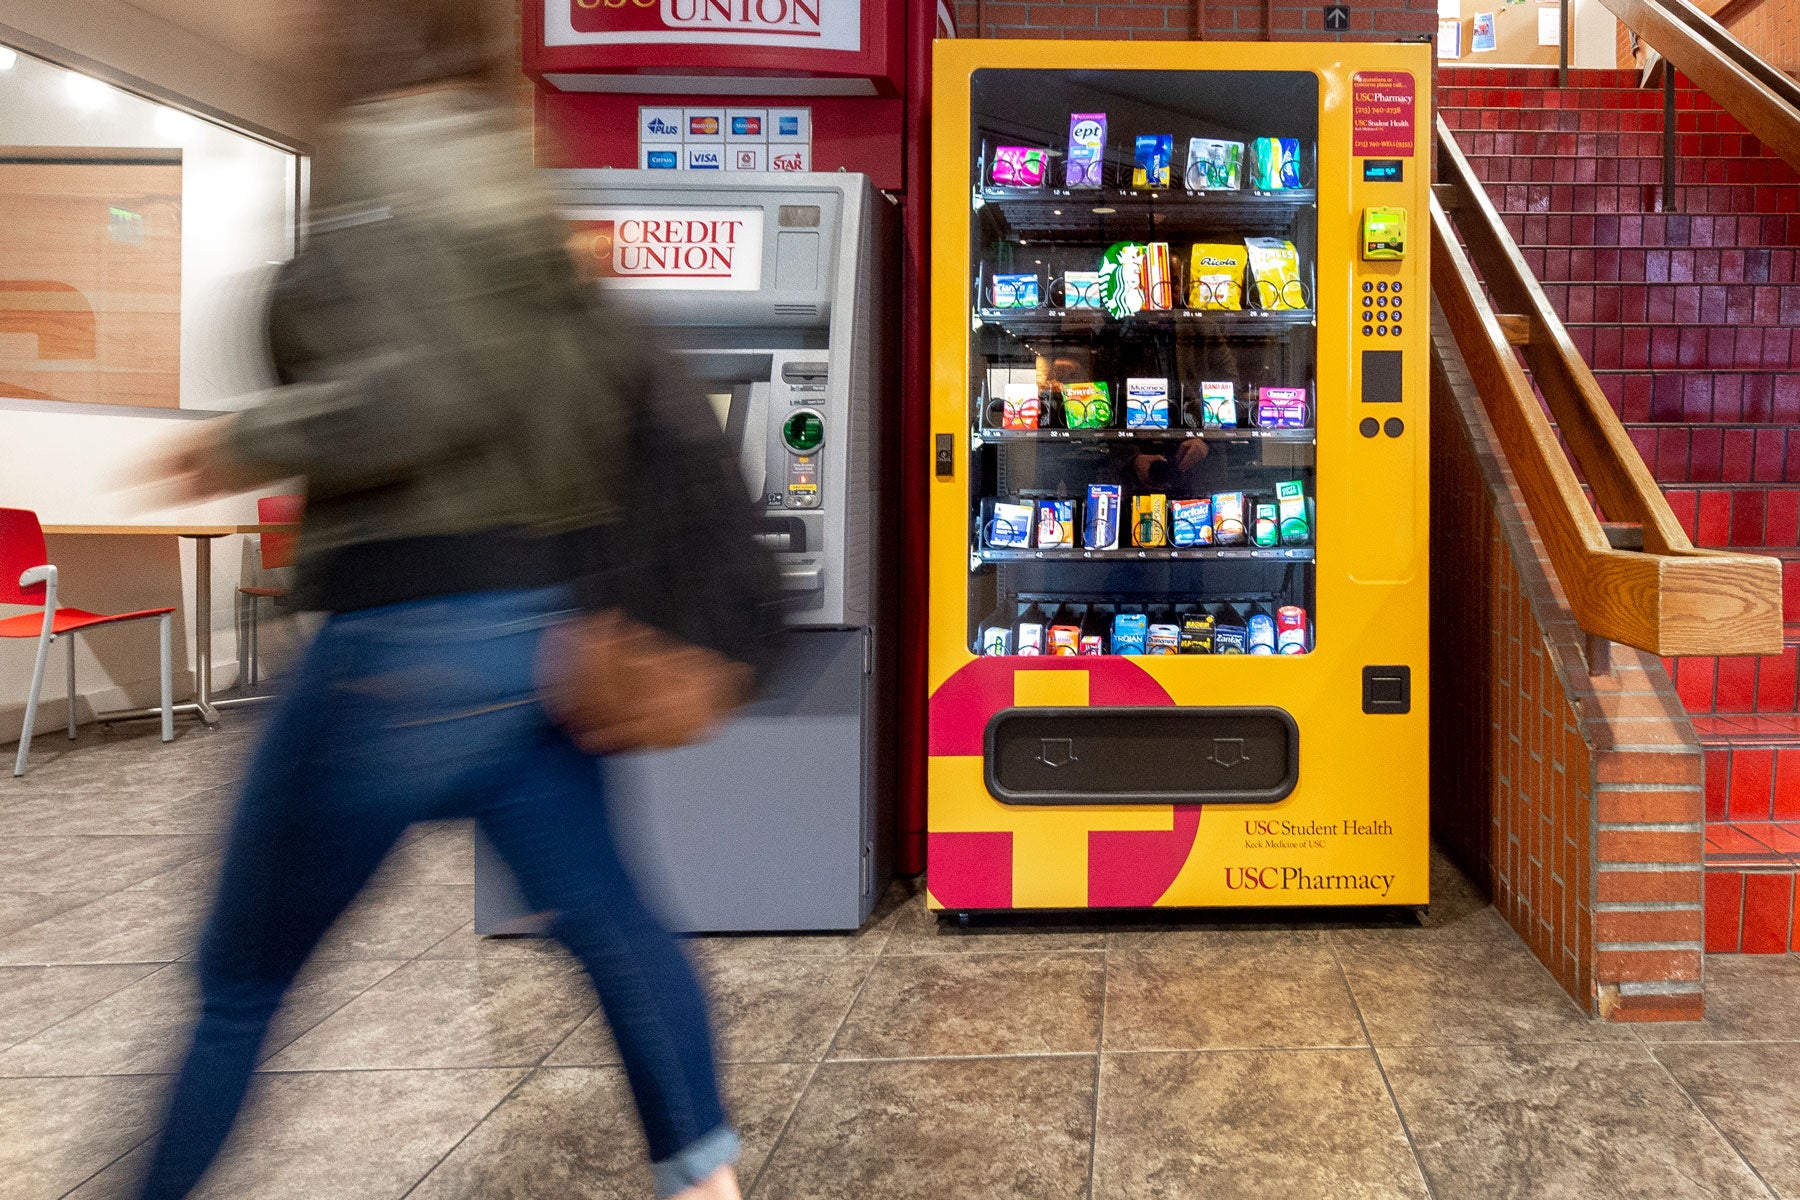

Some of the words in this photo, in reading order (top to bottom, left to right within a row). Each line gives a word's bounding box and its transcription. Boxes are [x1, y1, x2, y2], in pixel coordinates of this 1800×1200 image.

[671, 0, 821, 26] UNION
[1355, 93, 1374, 102] USC
[1374, 93, 1413, 105] Pharmacy
[1367, 119, 1389, 127] Student
[1390, 119, 1410, 127] Health
[655, 125, 678, 135] PLUS
[1074, 126, 1100, 140] ept
[694, 153, 718, 163] VISA
[773, 160, 803, 171] STAR
[619, 219, 743, 244] CREDIT
[620, 246, 736, 270] UNION
[1200, 256, 1237, 267] Ricola
[1113, 634, 1144, 644] TROJAN
[1245, 820, 1280, 836] USC
[1281, 820, 1337, 836] Student
[1342, 820, 1393, 836] Health
[1245, 840, 1263, 849] Keck
[1265, 840, 1298, 849] Medicine
[1298, 840, 1308, 849] of
[1308, 840, 1326, 849] USC
[1224, 866, 1279, 890] USC
[1280, 866, 1395, 897] Pharmacy
